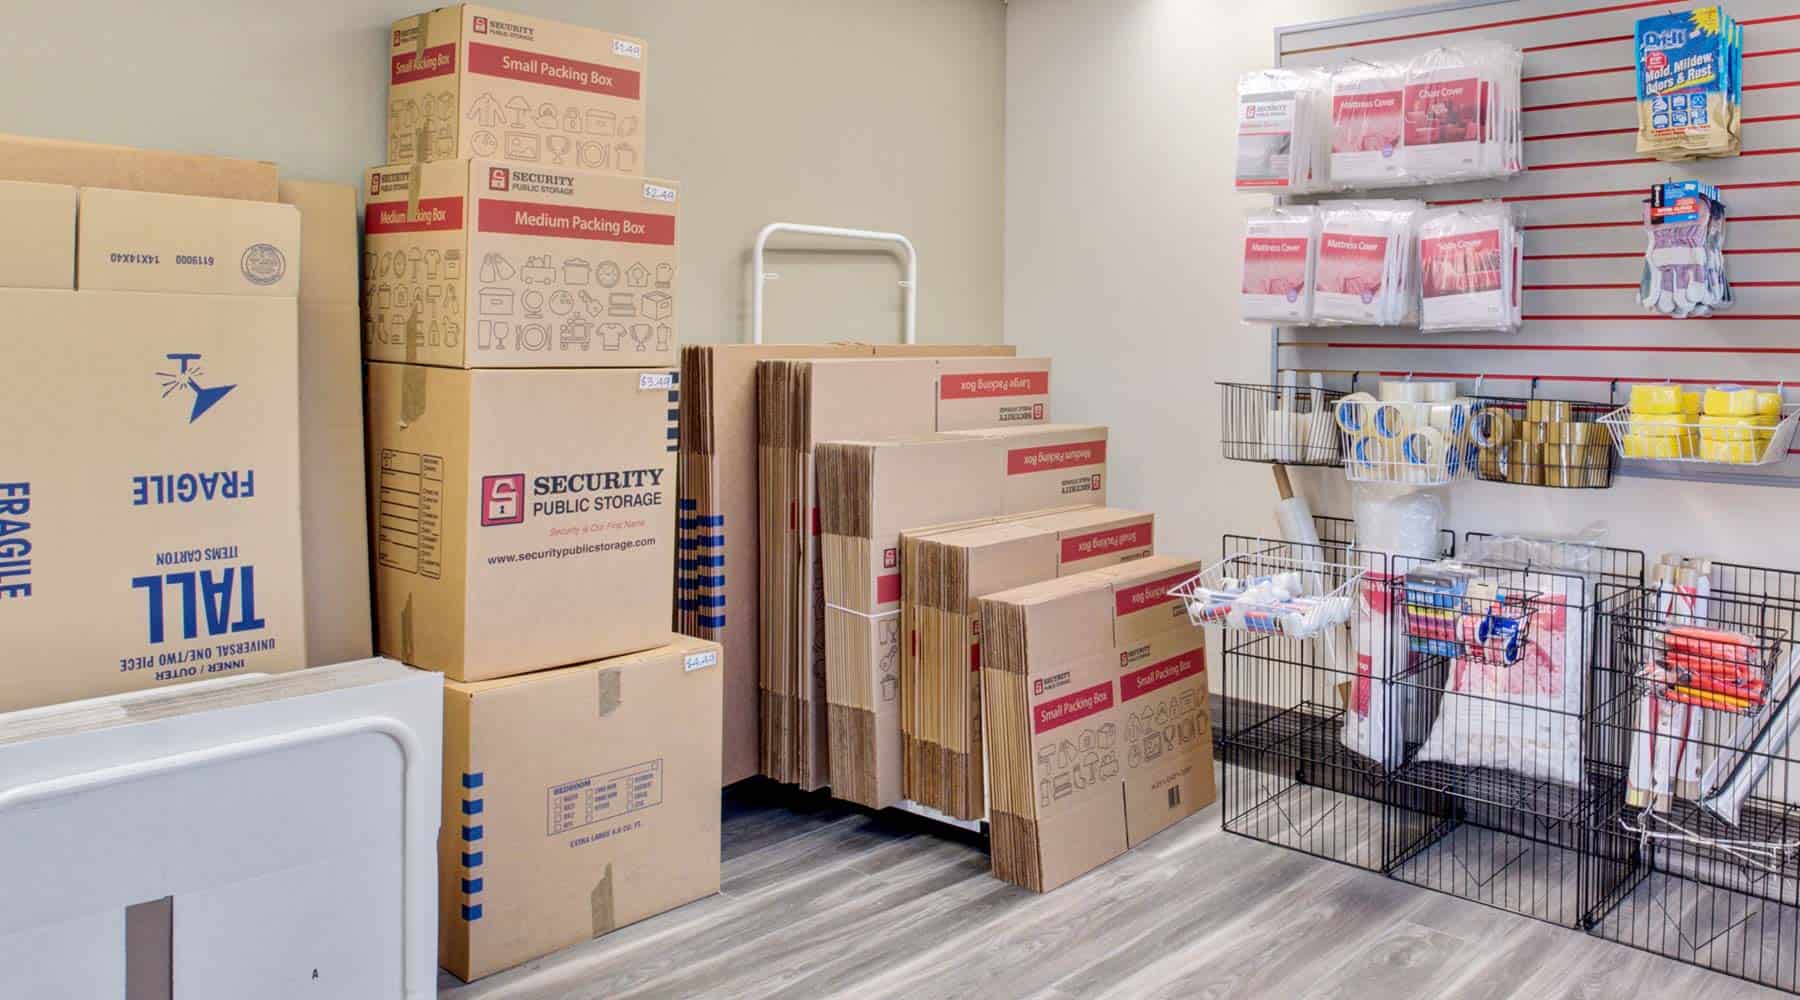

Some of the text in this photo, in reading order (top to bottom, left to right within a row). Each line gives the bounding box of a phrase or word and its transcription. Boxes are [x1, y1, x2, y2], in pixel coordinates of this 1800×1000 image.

[490, 20, 534, 36] SECURITY
[503, 56, 613, 87] Small Packing Box
[1688, 64, 1712, 80] Rust
[512, 170, 575, 187] SECURITY
[512, 183, 574, 196] PUBLIC STORAGE
[514, 210, 645, 236] Medium Packing Box
[1251, 243, 1300, 252] Mattress Cover
[1327, 239, 1378, 251] Mattress Cover
[960, 378, 1031, 391] Large Packing Box
[1024, 453, 1038, 465] Box
[133, 469, 255, 506] FRAGILE
[533, 468, 664, 496] SECURITY
[533, 491, 663, 517] PUBLIC STORAGE
[0, 482, 32, 600] FRAGILE
[488, 536, 656, 565] www.securitypublicstorage.com
[1078, 541, 1092, 553] Box
[156, 545, 239, 566] ITEMS CARTON
[131, 565, 265, 645] TALL
[120, 638, 276, 672] UNIVERSAL ONE/TWO PIECE
[155, 665, 197, 681] OUTER
[207, 658, 245, 673] INNER
[1136, 672, 1155, 688] Small
[1157, 664, 1179, 682] Packing
[1041, 690, 1108, 723] Small Packing Box
[311, 968, 319, 980] A
